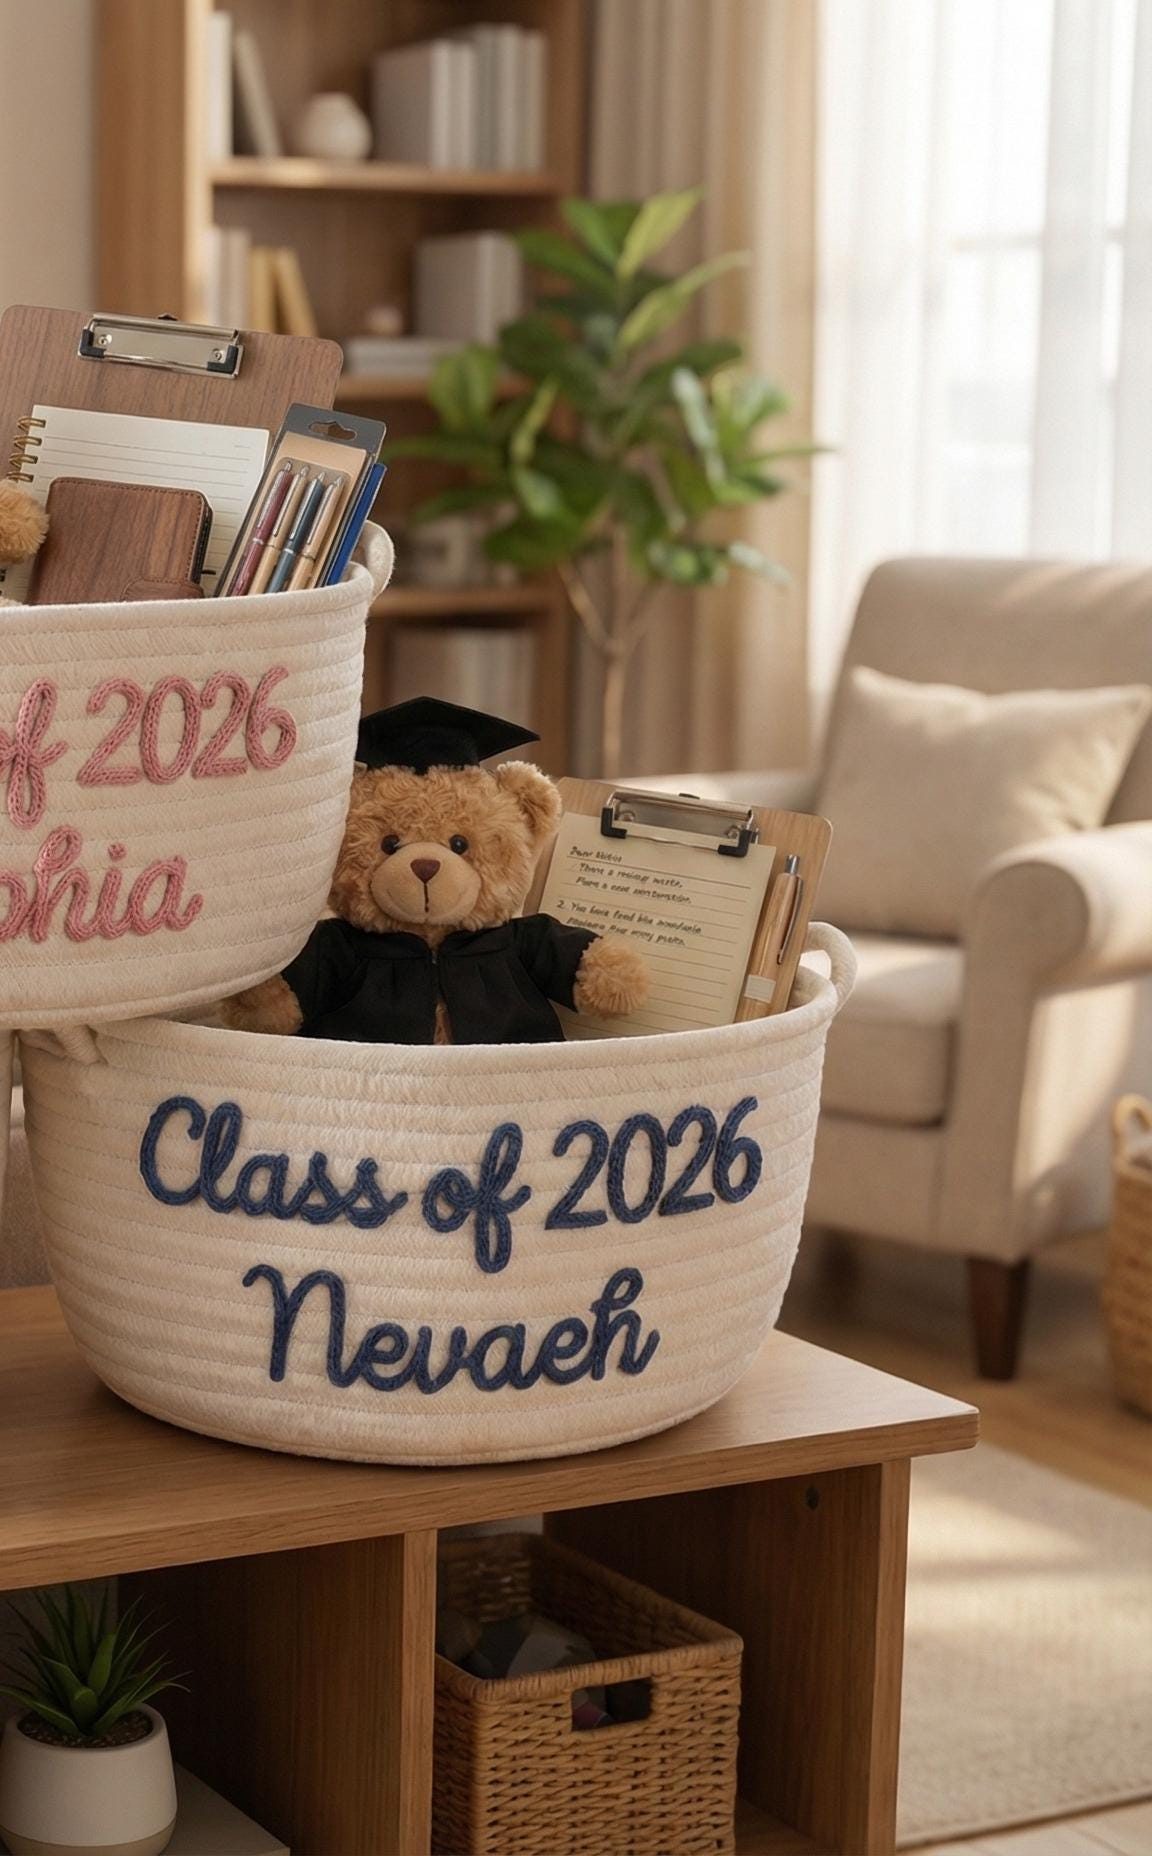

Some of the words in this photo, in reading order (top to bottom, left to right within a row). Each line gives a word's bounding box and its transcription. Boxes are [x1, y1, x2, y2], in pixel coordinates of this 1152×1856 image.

[76, 665, 297, 788] 2026
[139, 1095, 408, 1228] Class
[422, 1122, 532, 1273] of
[545, 1096, 762, 1230] 2026
[242, 1264, 660, 1394] Nevaeh
